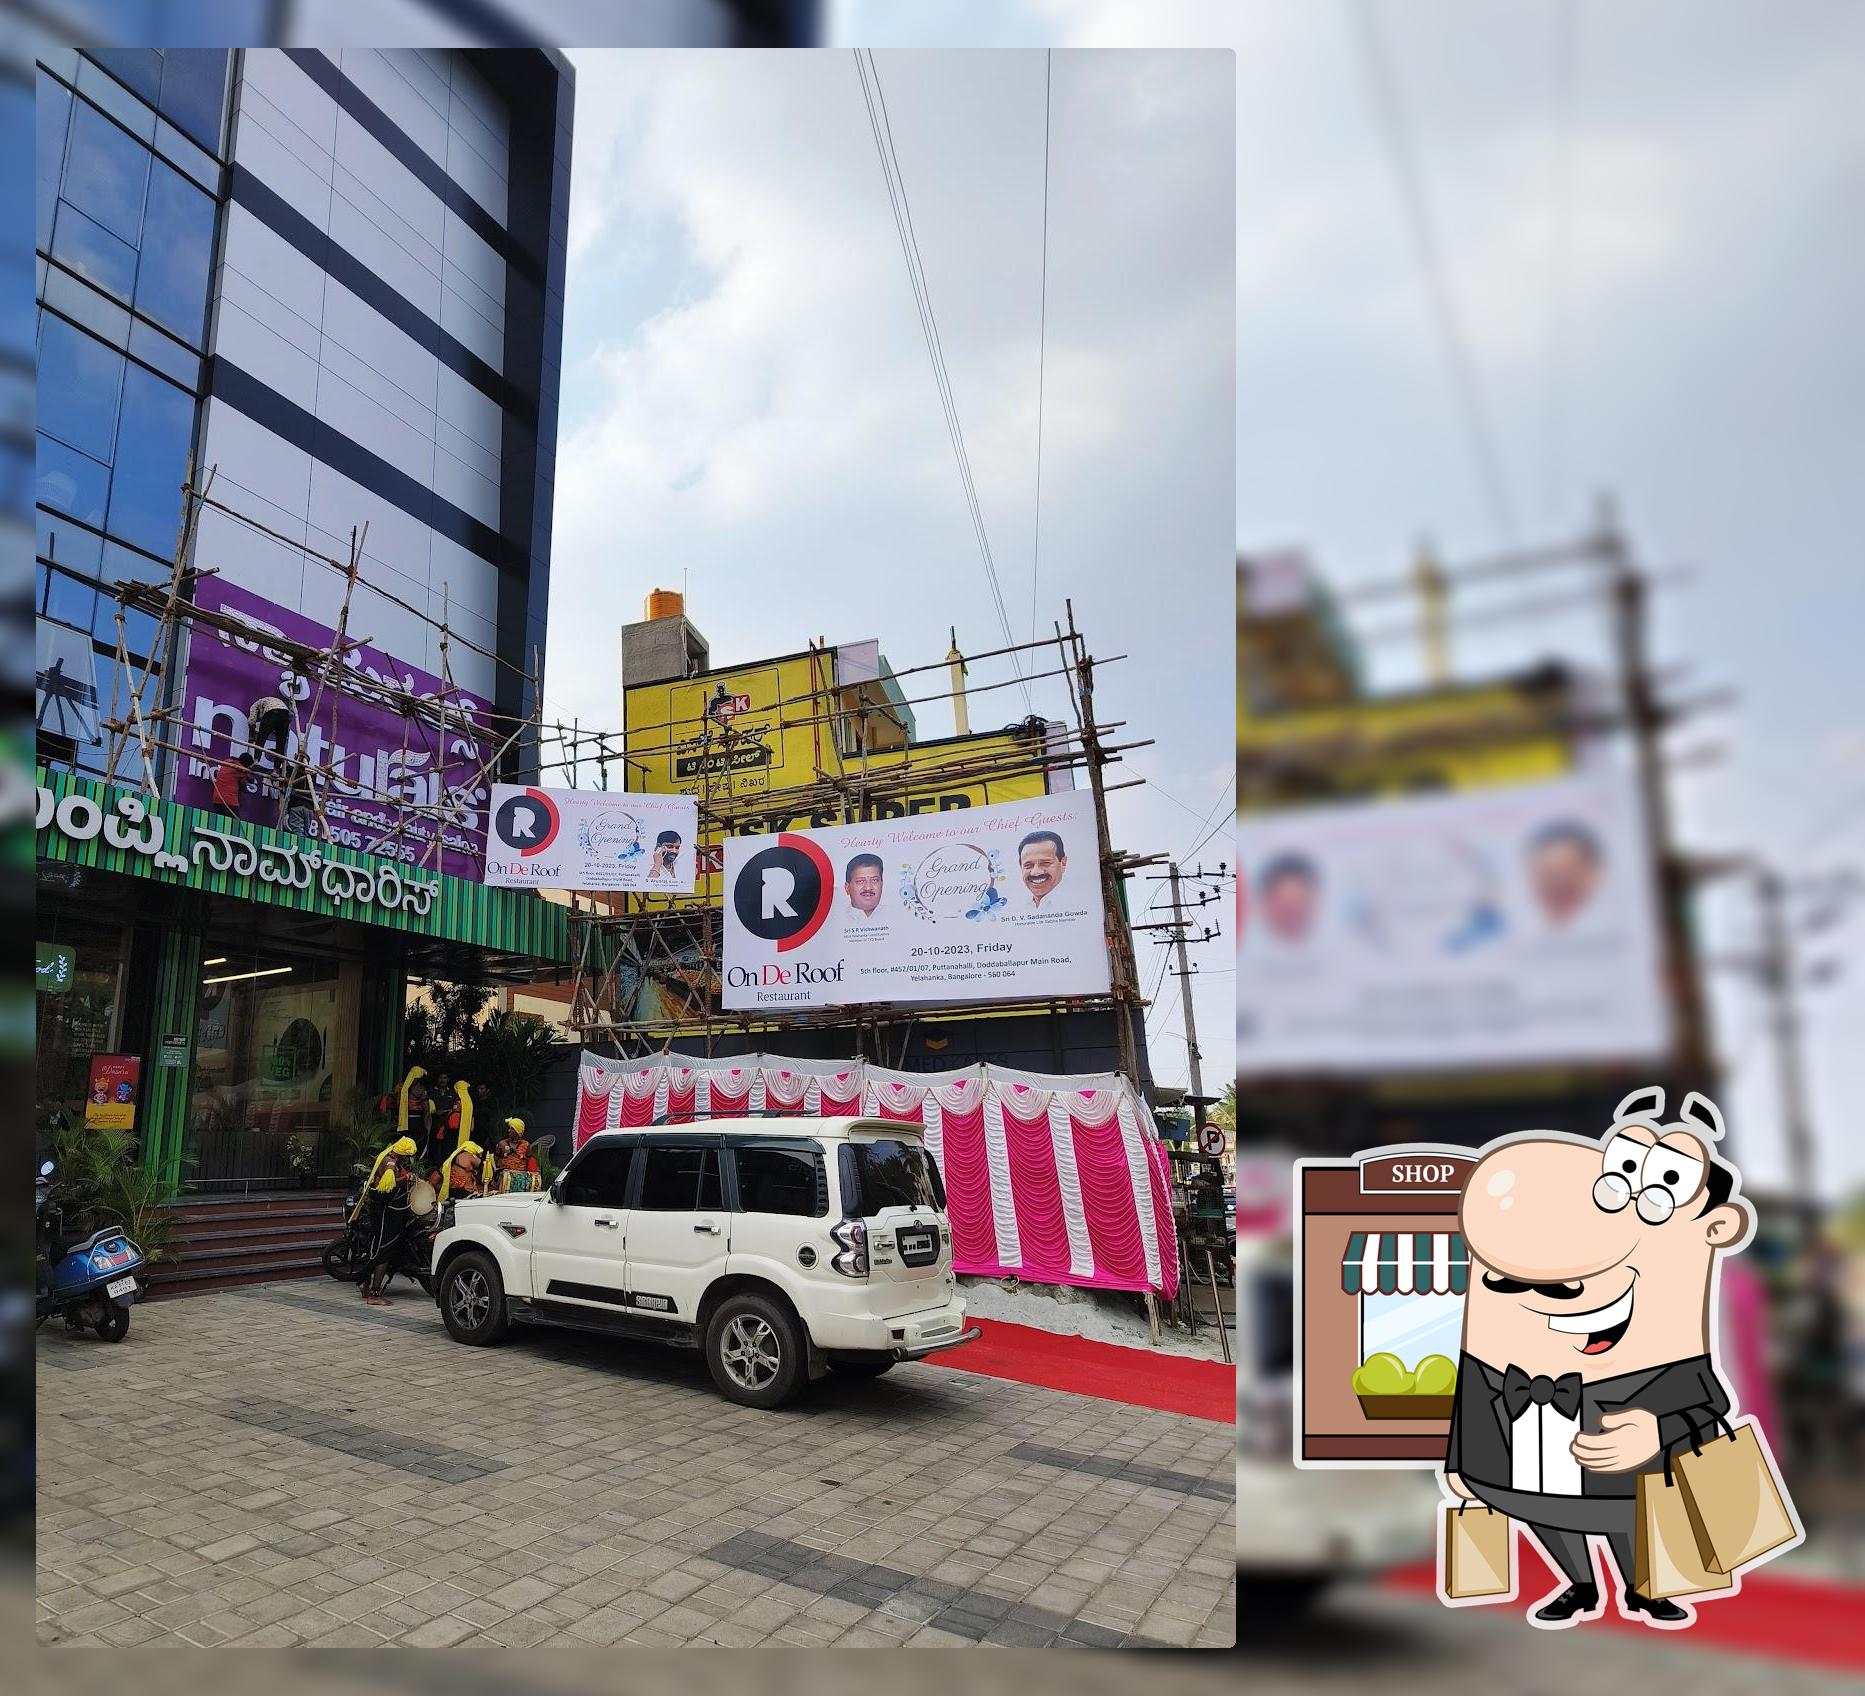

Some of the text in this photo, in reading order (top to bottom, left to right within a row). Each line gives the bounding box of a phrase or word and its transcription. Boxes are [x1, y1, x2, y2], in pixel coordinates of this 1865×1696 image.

[315, 795, 349, 818] air
[308, 820, 362, 848] 8505
[595, 819, 634, 832] Grand
[887, 830, 942, 844] Welcome
[944, 828, 956, 837] to
[959, 826, 981, 835] our
[983, 815, 1020, 832] Chief
[591, 832, 636, 848] Opening
[487, 862, 561, 877] On De Roof
[925, 856, 982, 879] Grand
[505, 877, 539, 885] Restaurant
[920, 880, 988, 903] Opening
[1027, 912, 1063, 920] Sadananda
[1064, 909, 1088, 917] Gowda
[911, 942, 1013, 957] 20-10-2023, Friday
[727, 959, 845, 988] On De Roof
[860, 956, 1072, 975] 5th floor, #452/01/07, Puttanahalli, Doddaballapur Main Road,
[910, 974, 946, 983] Yelahanka,
[948, 972, 982, 981] Bangalore
[1002, 970, 1016, 978] 064
[757, 991, 811, 1002] Restaurant
[1207, 1131, 1219, 1150] P
